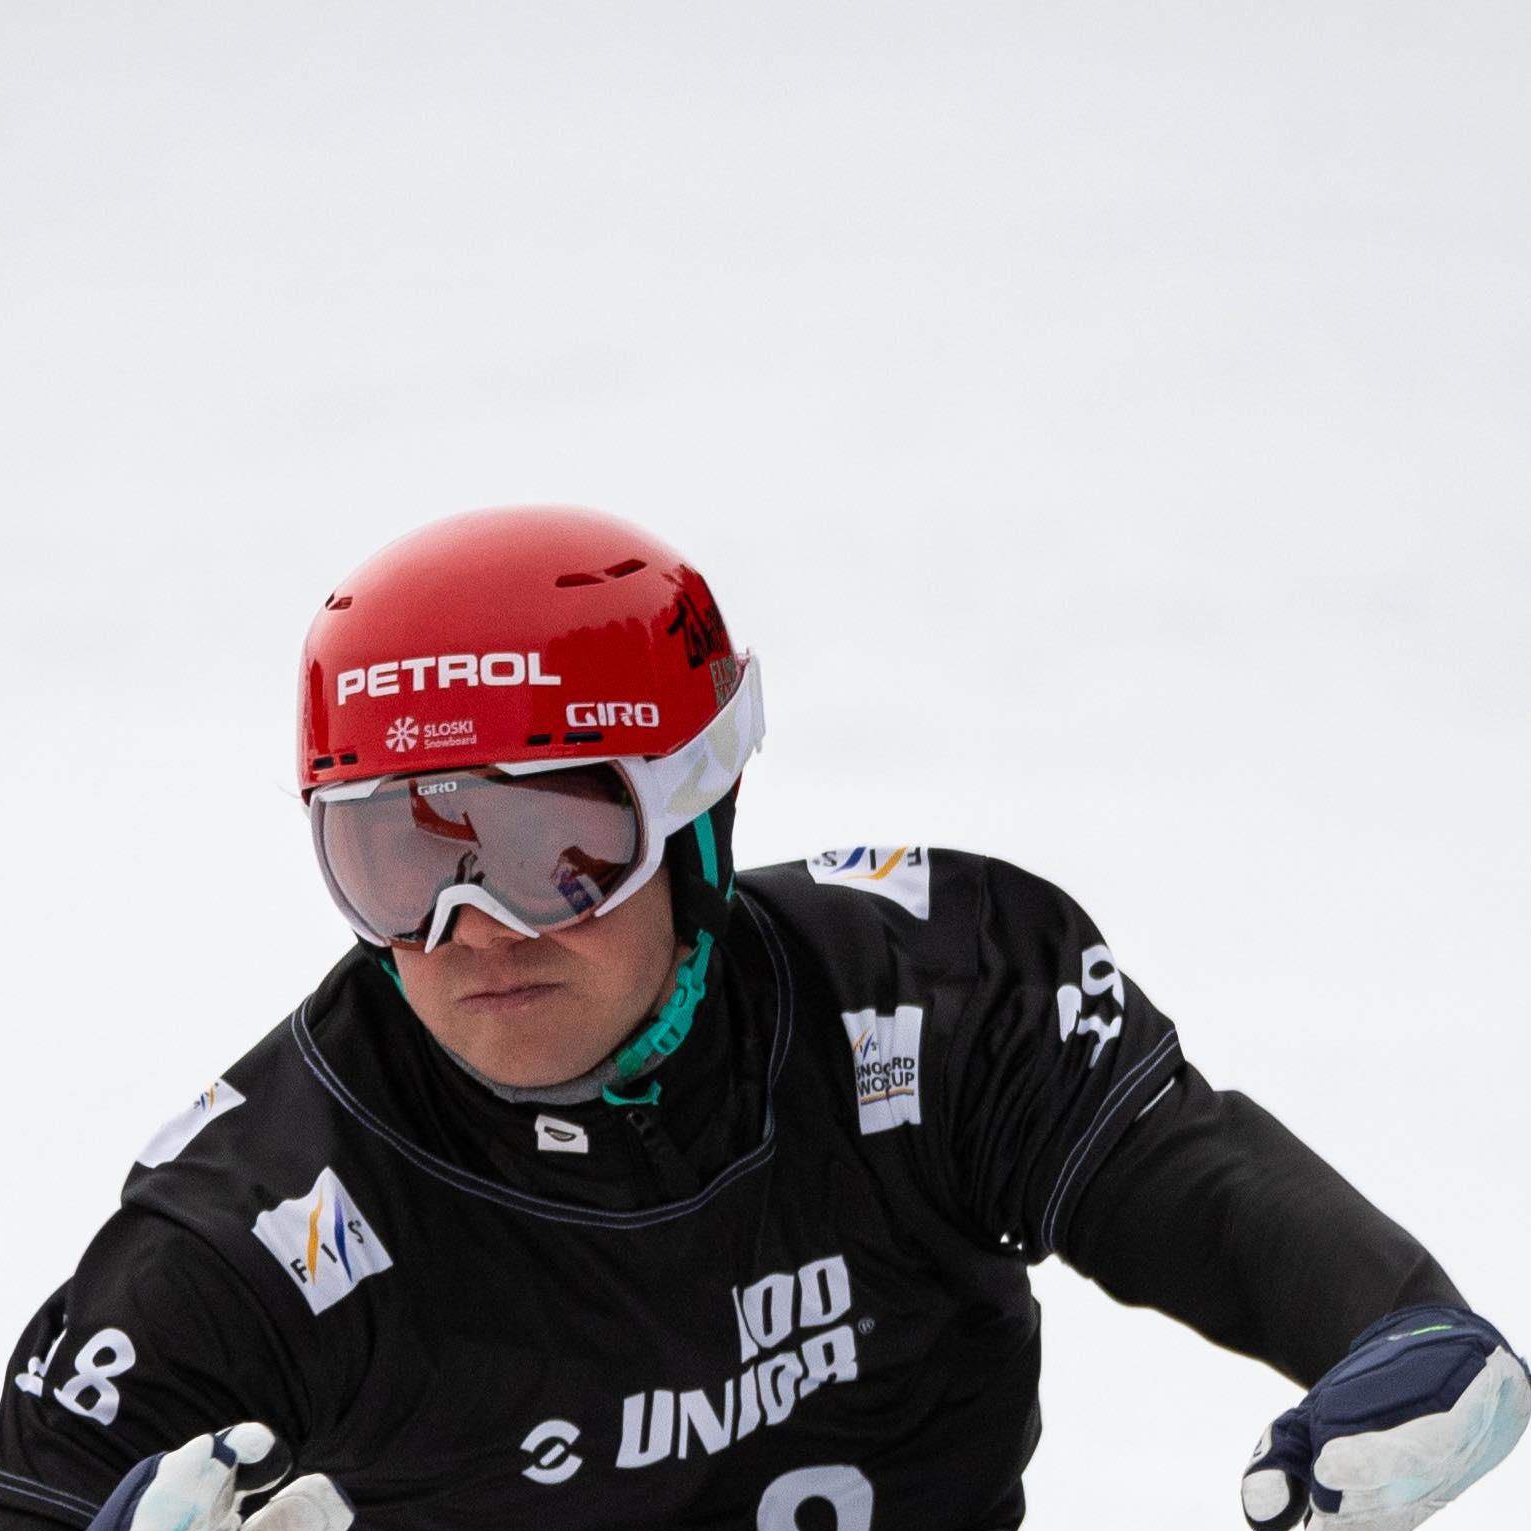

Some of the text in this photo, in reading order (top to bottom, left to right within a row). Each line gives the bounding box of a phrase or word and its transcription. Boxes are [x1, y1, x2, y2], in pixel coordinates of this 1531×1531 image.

[337, 652, 562, 706] PETROL
[566, 702, 660, 728] GIRO
[423, 720, 474, 738] SLOSKI
[423, 733, 477, 750] Snowboard
[417, 781, 457, 796] GIRO
[289, 1219, 365, 1284] FIS
[615, 1325, 858, 1469] UNIOR
